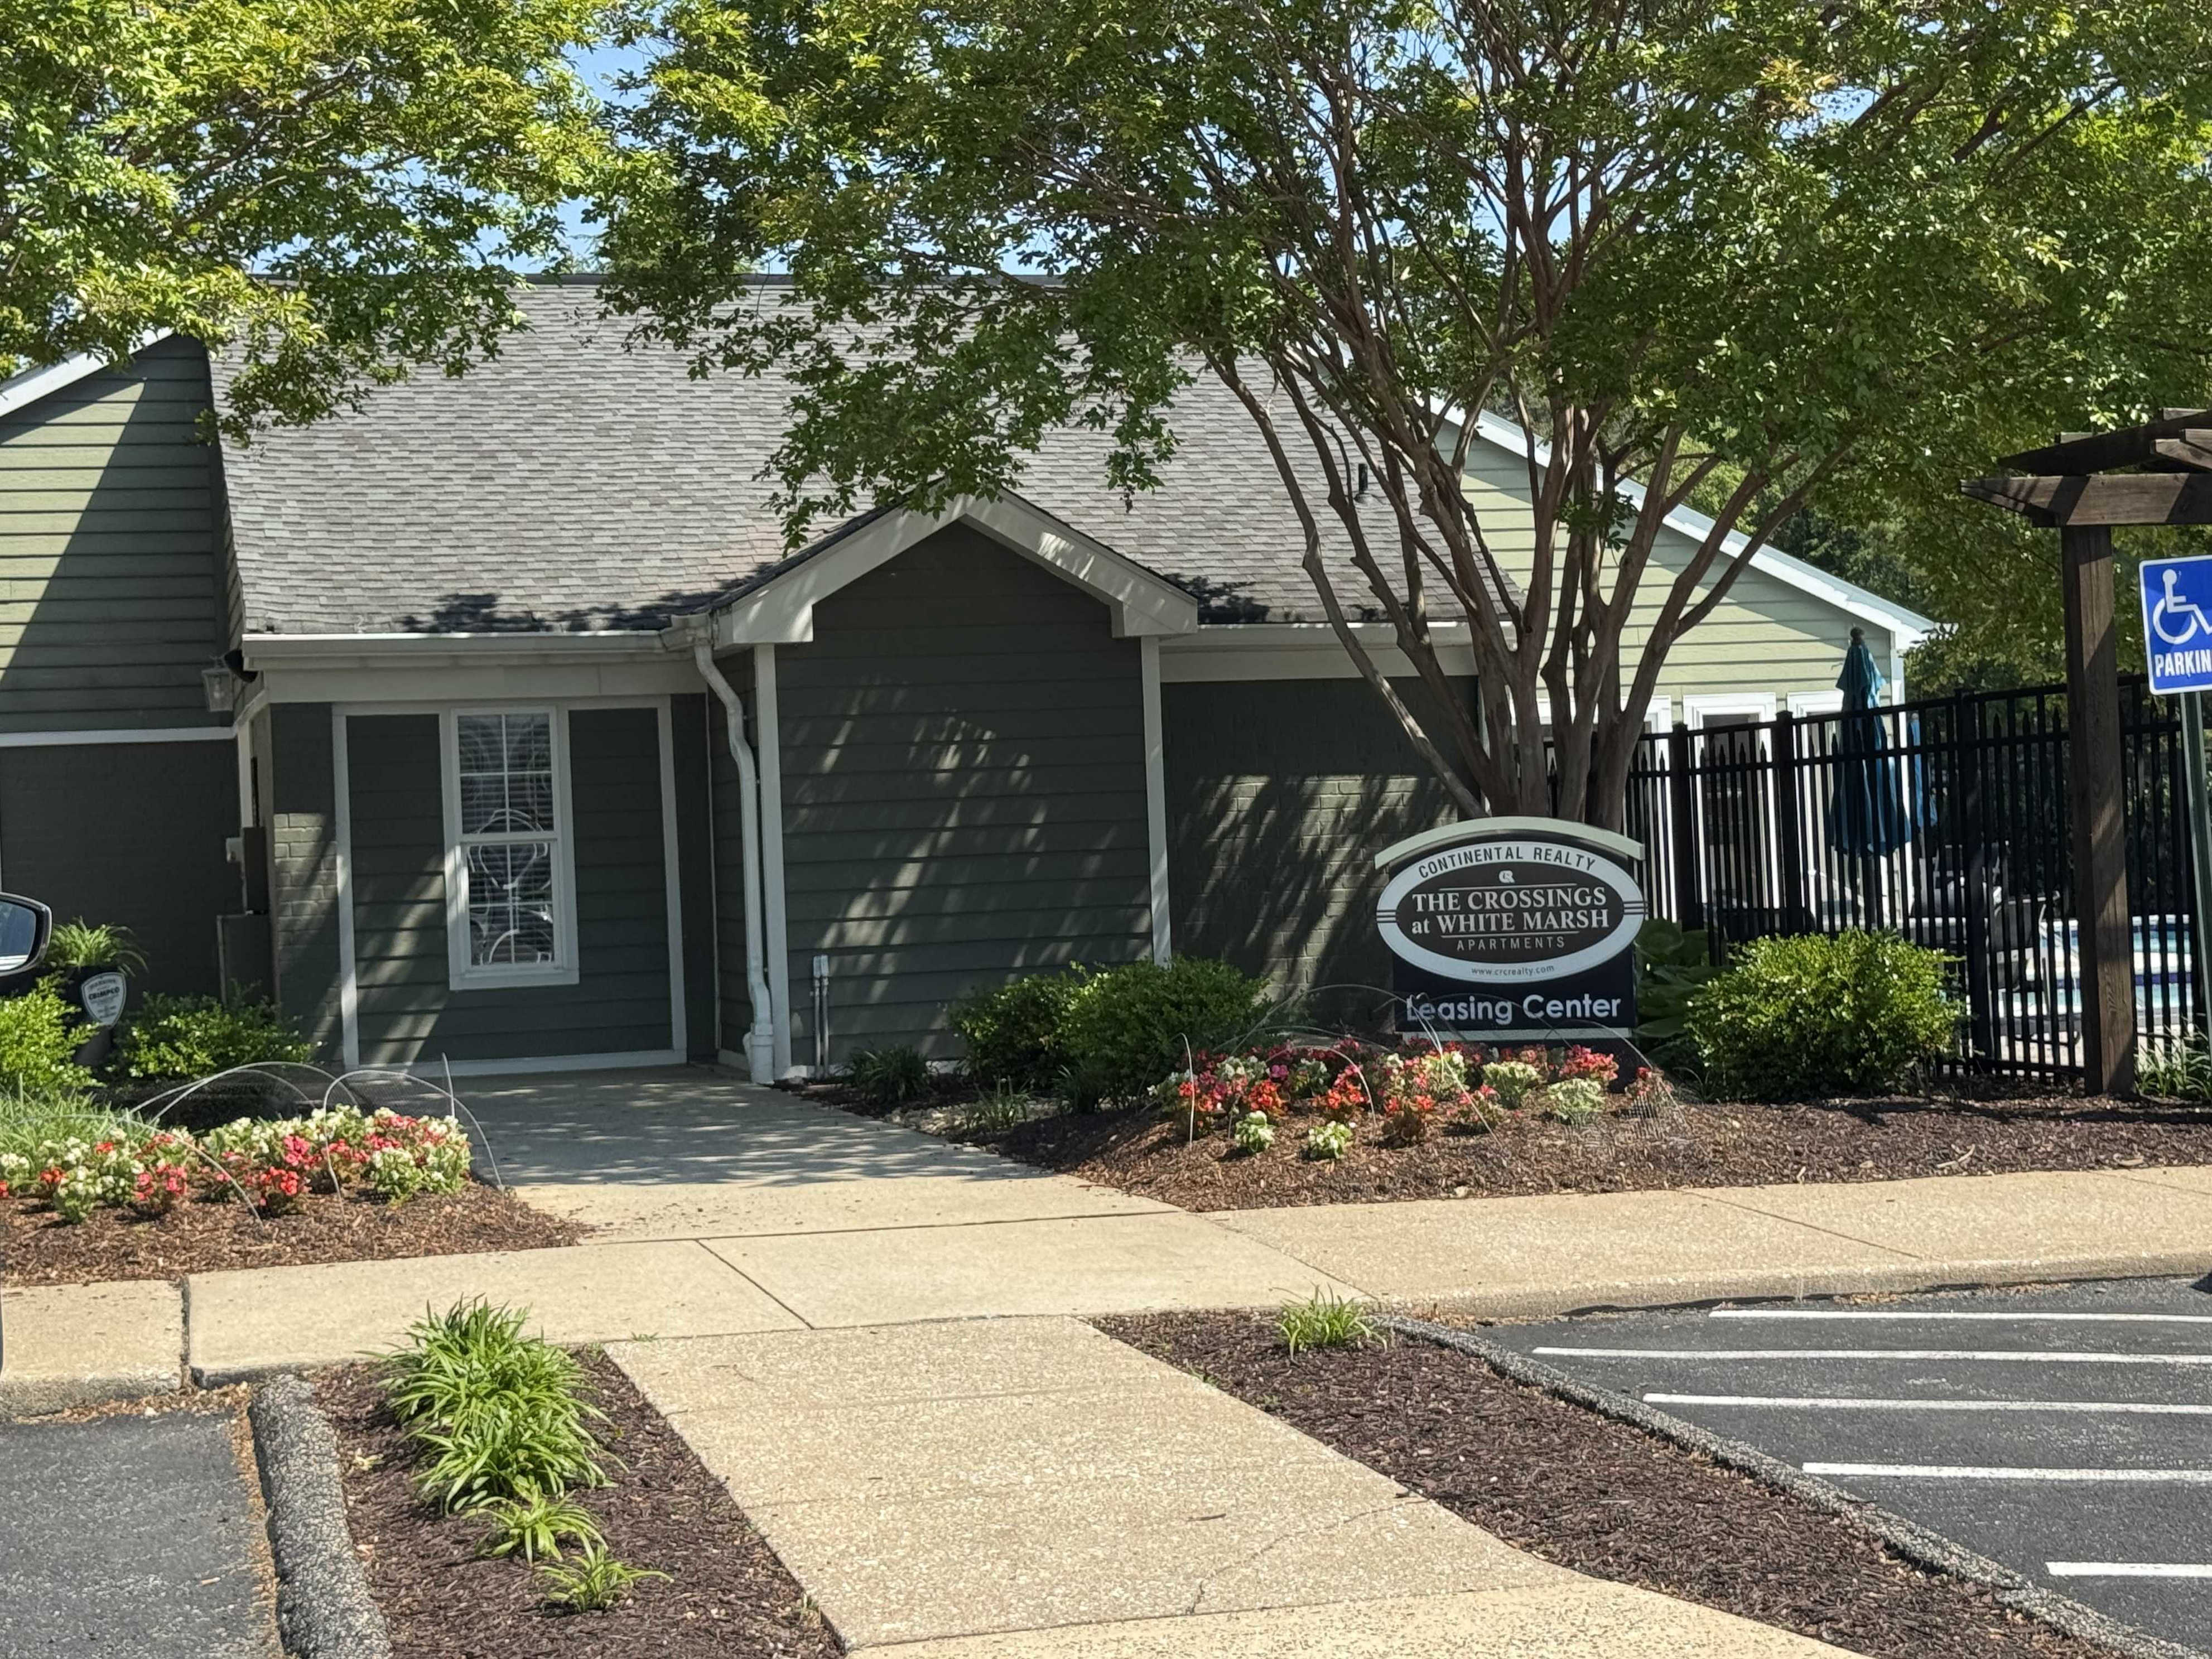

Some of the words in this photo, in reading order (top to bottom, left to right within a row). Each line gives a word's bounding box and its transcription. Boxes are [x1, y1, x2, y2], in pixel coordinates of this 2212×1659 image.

[1419, 846, 1524, 878] CONTINENTAL
[1534, 847, 1596, 871] REALTY
[1412, 893, 1461, 912] THE
[1468, 886, 1607, 910] CROSSINGS
[1411, 918, 1430, 934] at
[1436, 913, 1515, 933] WHITE
[1522, 909, 1609, 931] MARSH
[1457, 936, 1565, 951] APARTMENTS
[1471, 965, 1555, 976] www.crcrealty.com
[1406, 995, 1512, 1025] Leasing
[1523, 993, 1621, 1019] Center
